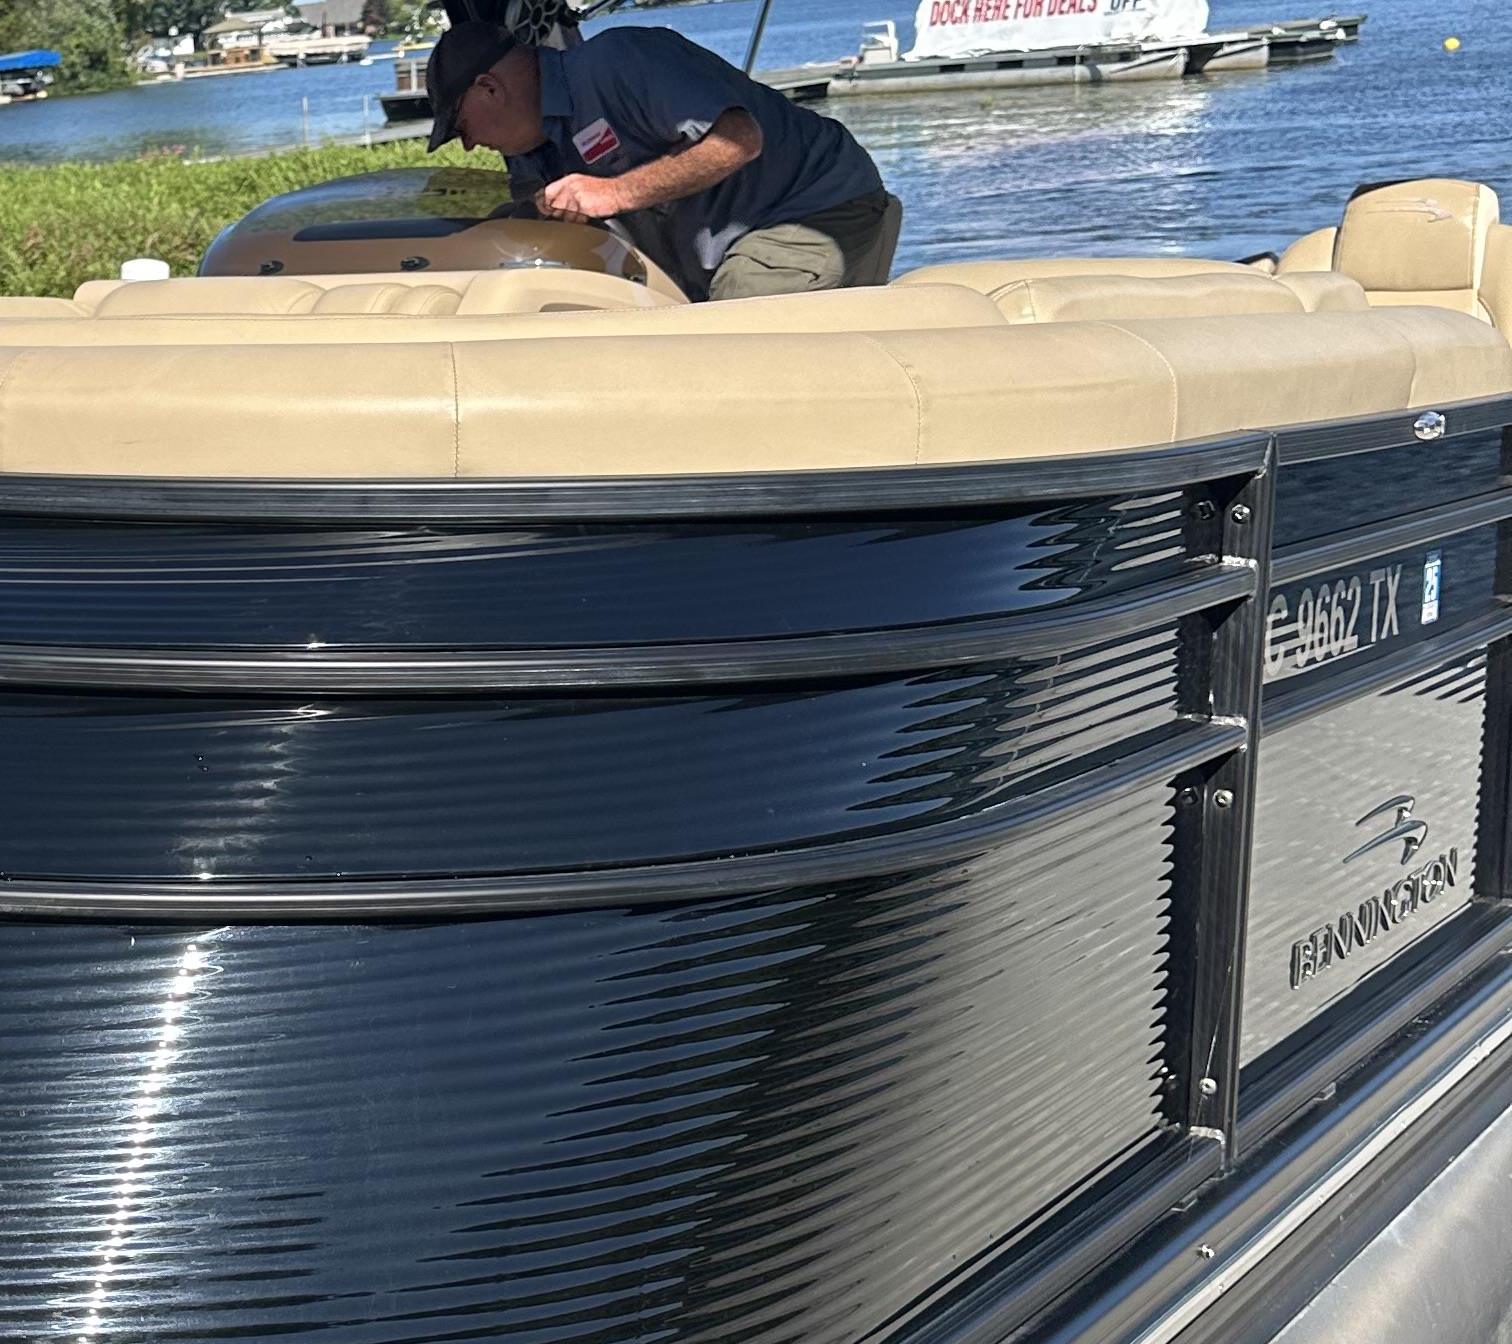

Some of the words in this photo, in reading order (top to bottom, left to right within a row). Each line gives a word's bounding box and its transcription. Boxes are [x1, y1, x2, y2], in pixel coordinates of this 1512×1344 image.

[1295, 575, 1362, 668] 9662
[1369, 563, 1403, 643] TX
[1289, 846, 1458, 991] BENNINGTON
